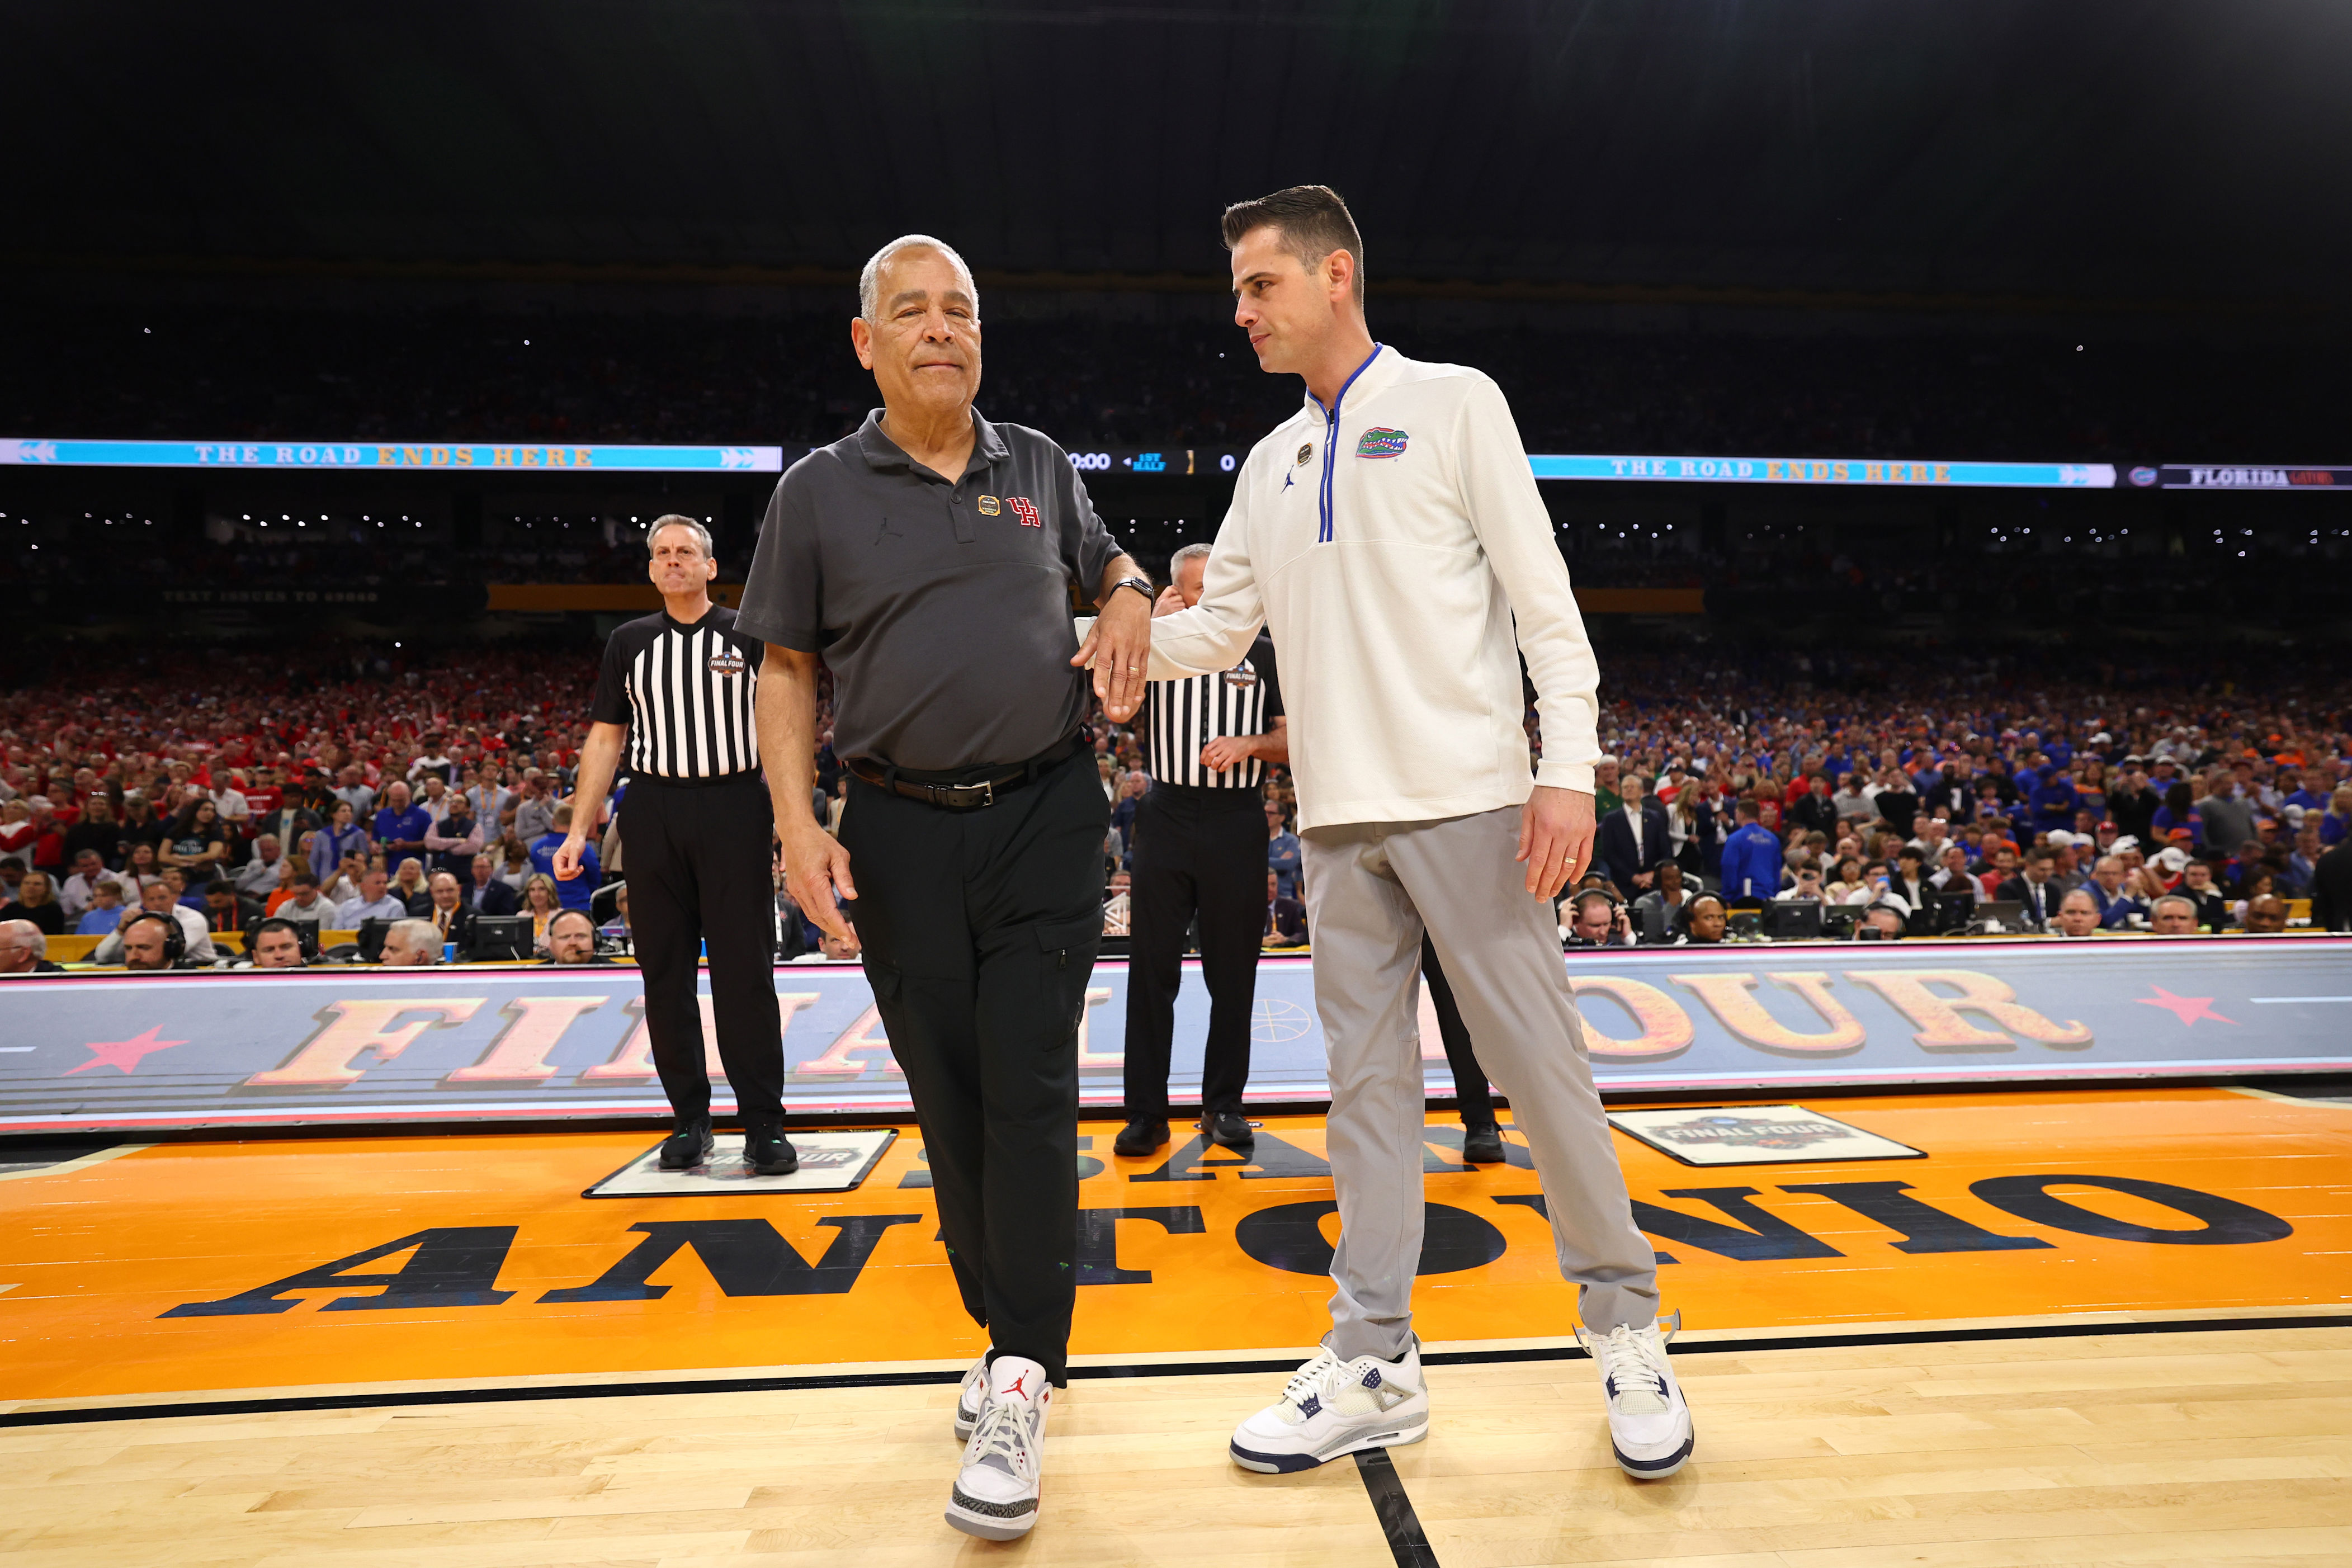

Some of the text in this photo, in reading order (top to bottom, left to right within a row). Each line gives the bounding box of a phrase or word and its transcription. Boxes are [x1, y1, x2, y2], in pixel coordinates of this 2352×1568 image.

[195, 446, 593, 466] THE ROAD ENDS HERE
[1138, 452, 1162, 462] 1ST
[1220, 454, 1236, 472] 0
[1132, 462, 1166, 471] HALF
[1611, 459, 1950, 482] THE ROAD ENDS HERE
[2190, 468, 2290, 487] FLORIDA
[1005, 496, 1041, 528] UH
[728, 660, 744, 668] FOUR
[1241, 673, 1256, 681] FOUR
[1668, 1122, 1833, 1139] FINAL FOUR
[796, 1152, 852, 1163] OUR
